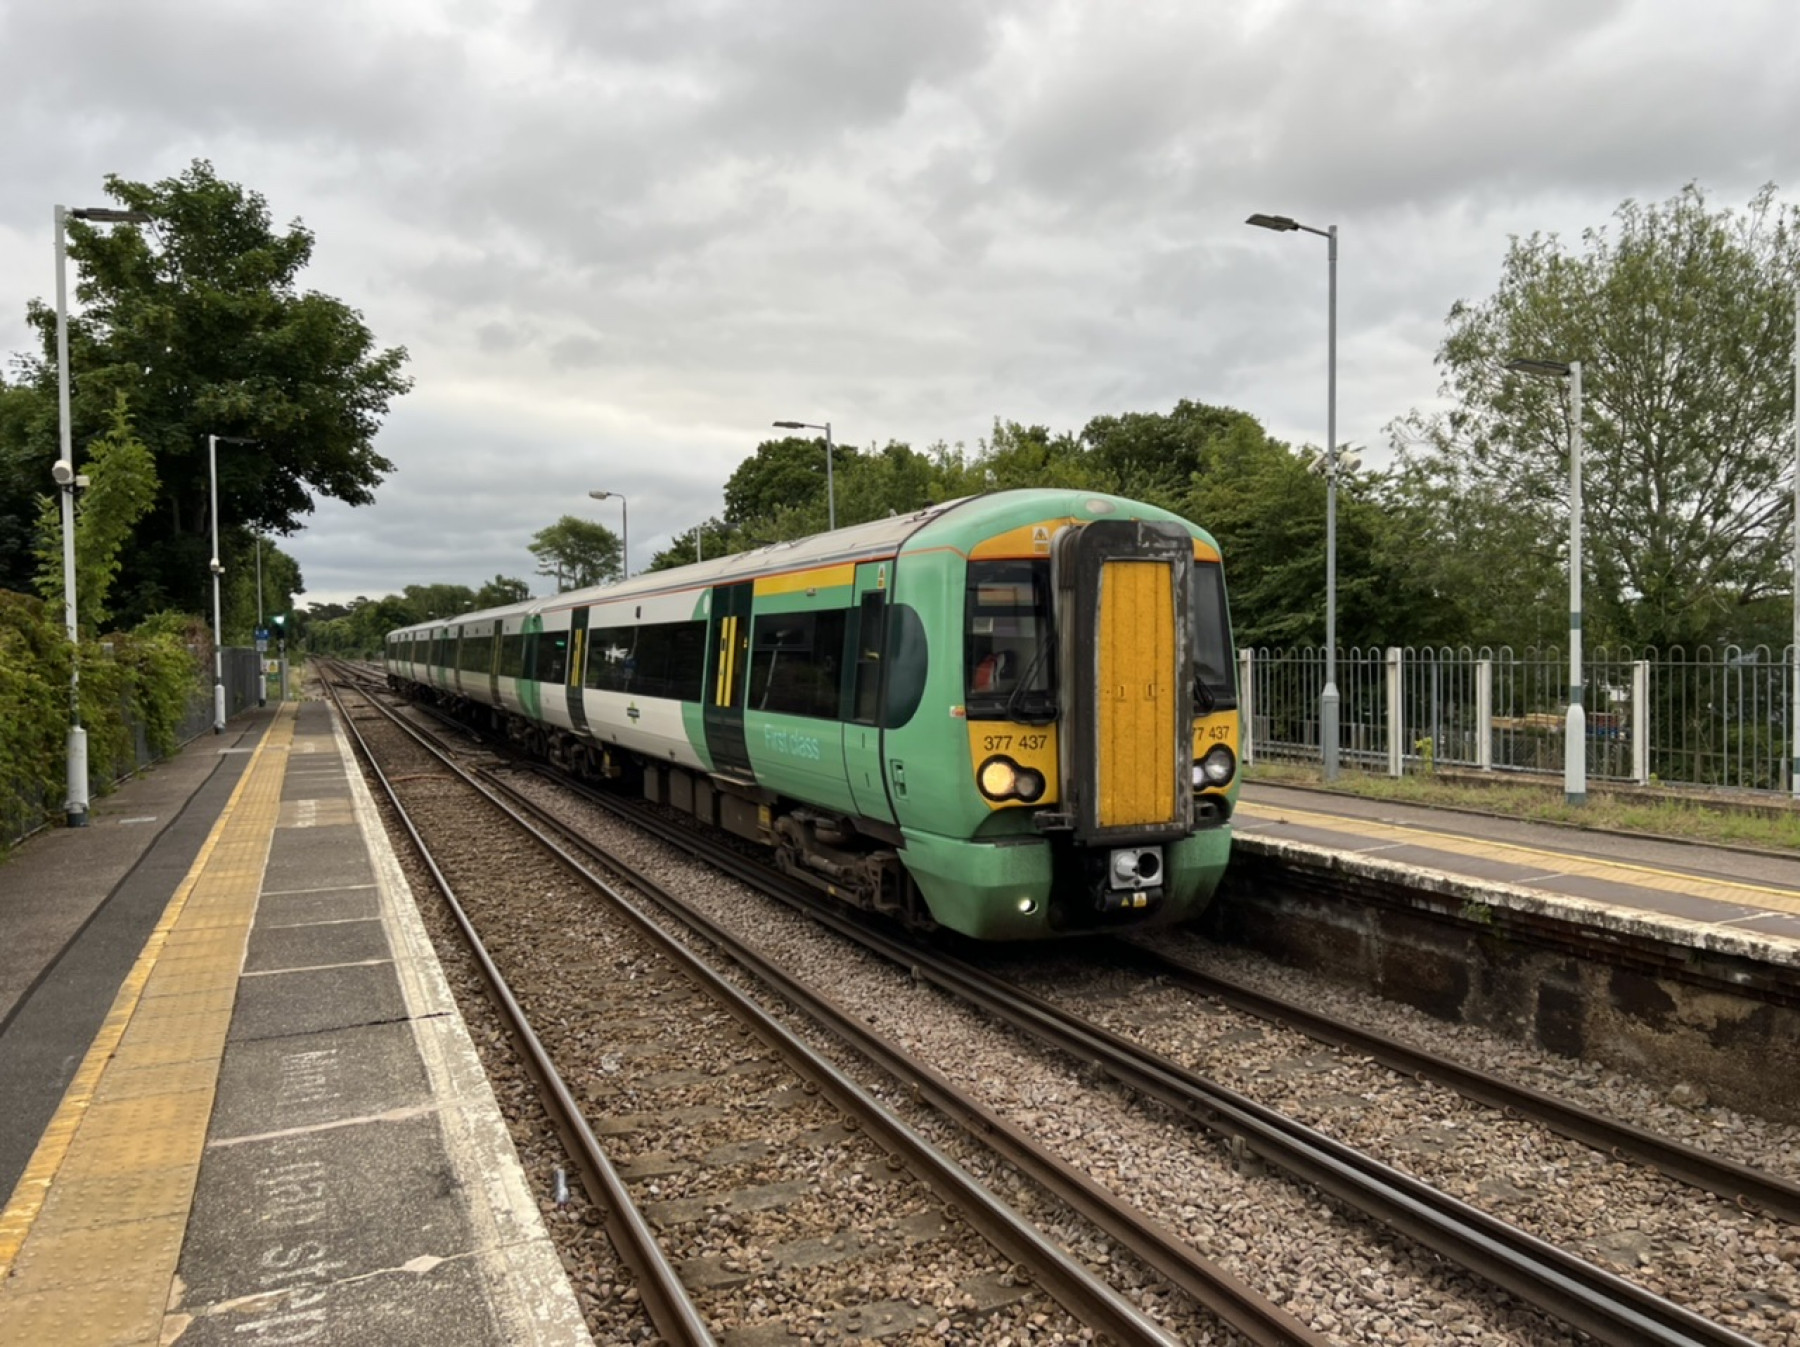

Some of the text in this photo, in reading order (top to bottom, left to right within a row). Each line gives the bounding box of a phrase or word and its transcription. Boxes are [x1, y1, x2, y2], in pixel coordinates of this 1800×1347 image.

[1208, 725, 1230, 740] 437
[764, 724, 820, 760] First class
[984, 735, 1048, 751] 377 437
